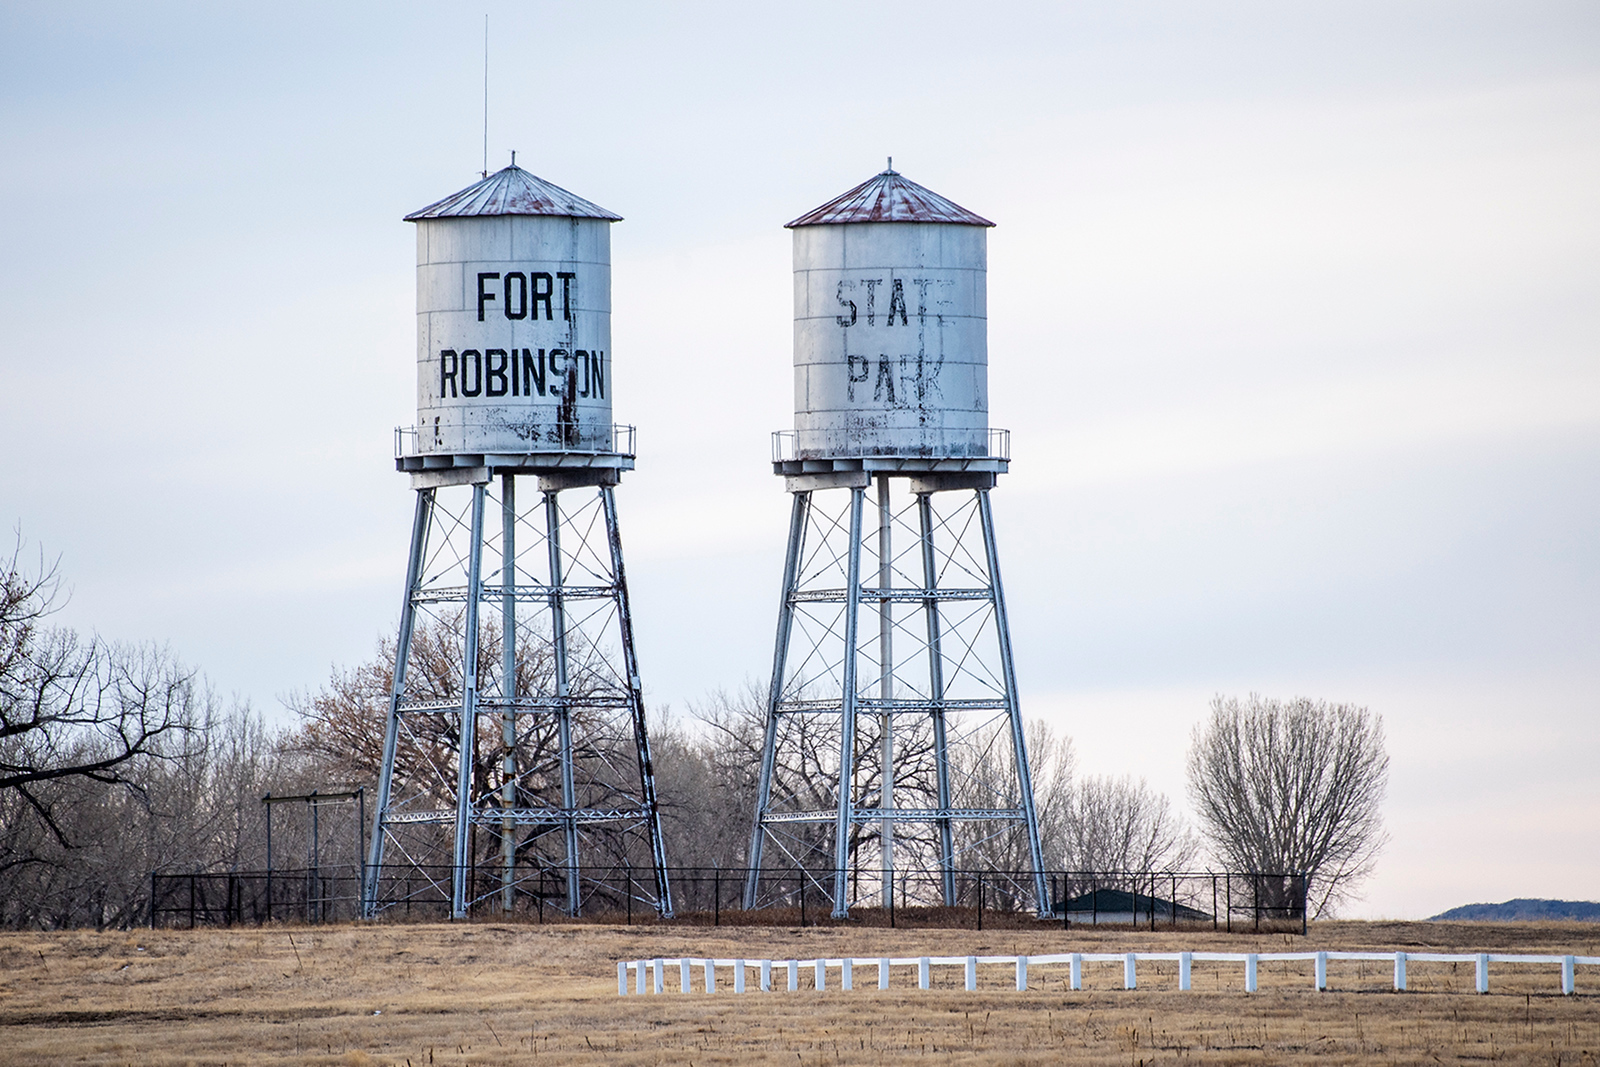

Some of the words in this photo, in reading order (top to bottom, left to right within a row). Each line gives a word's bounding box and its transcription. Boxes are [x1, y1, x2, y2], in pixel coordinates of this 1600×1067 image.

[477, 271, 576, 322] FORT
[440, 348, 604, 399] ROBINSON
[847, 354, 945, 402] PARK
